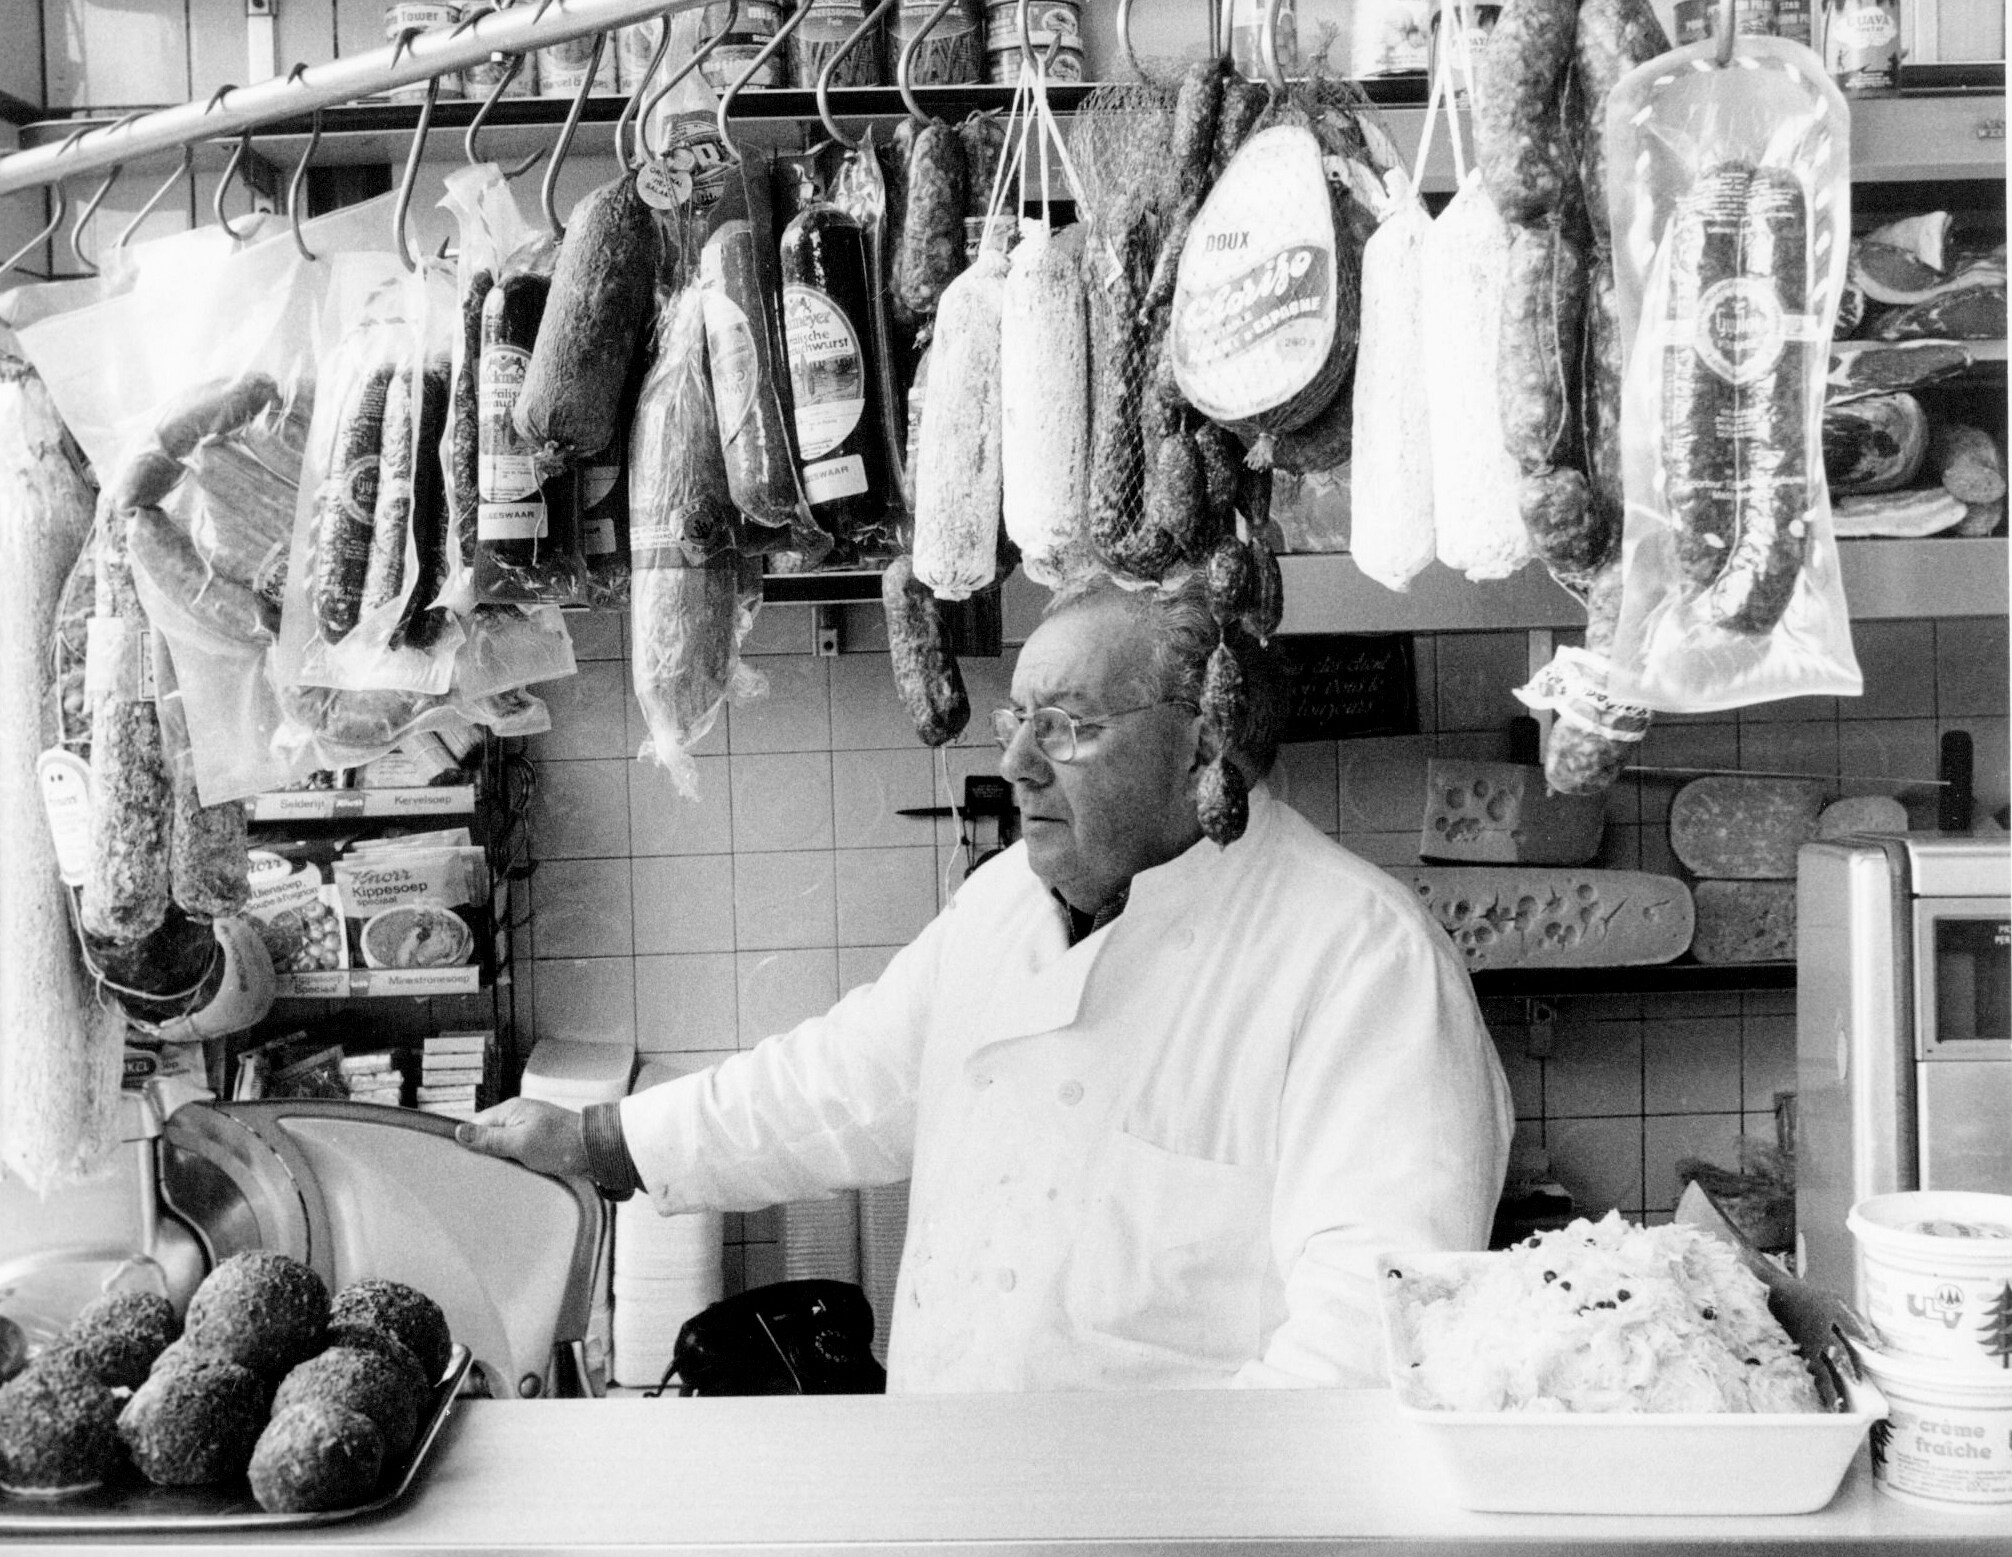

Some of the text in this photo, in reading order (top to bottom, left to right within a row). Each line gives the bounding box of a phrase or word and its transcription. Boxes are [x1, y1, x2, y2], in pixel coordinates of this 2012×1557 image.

[1205, 230, 1250, 251] DOUX
[350, 868, 412, 885] Knorr
[352, 880, 428, 898] Kippesoep
